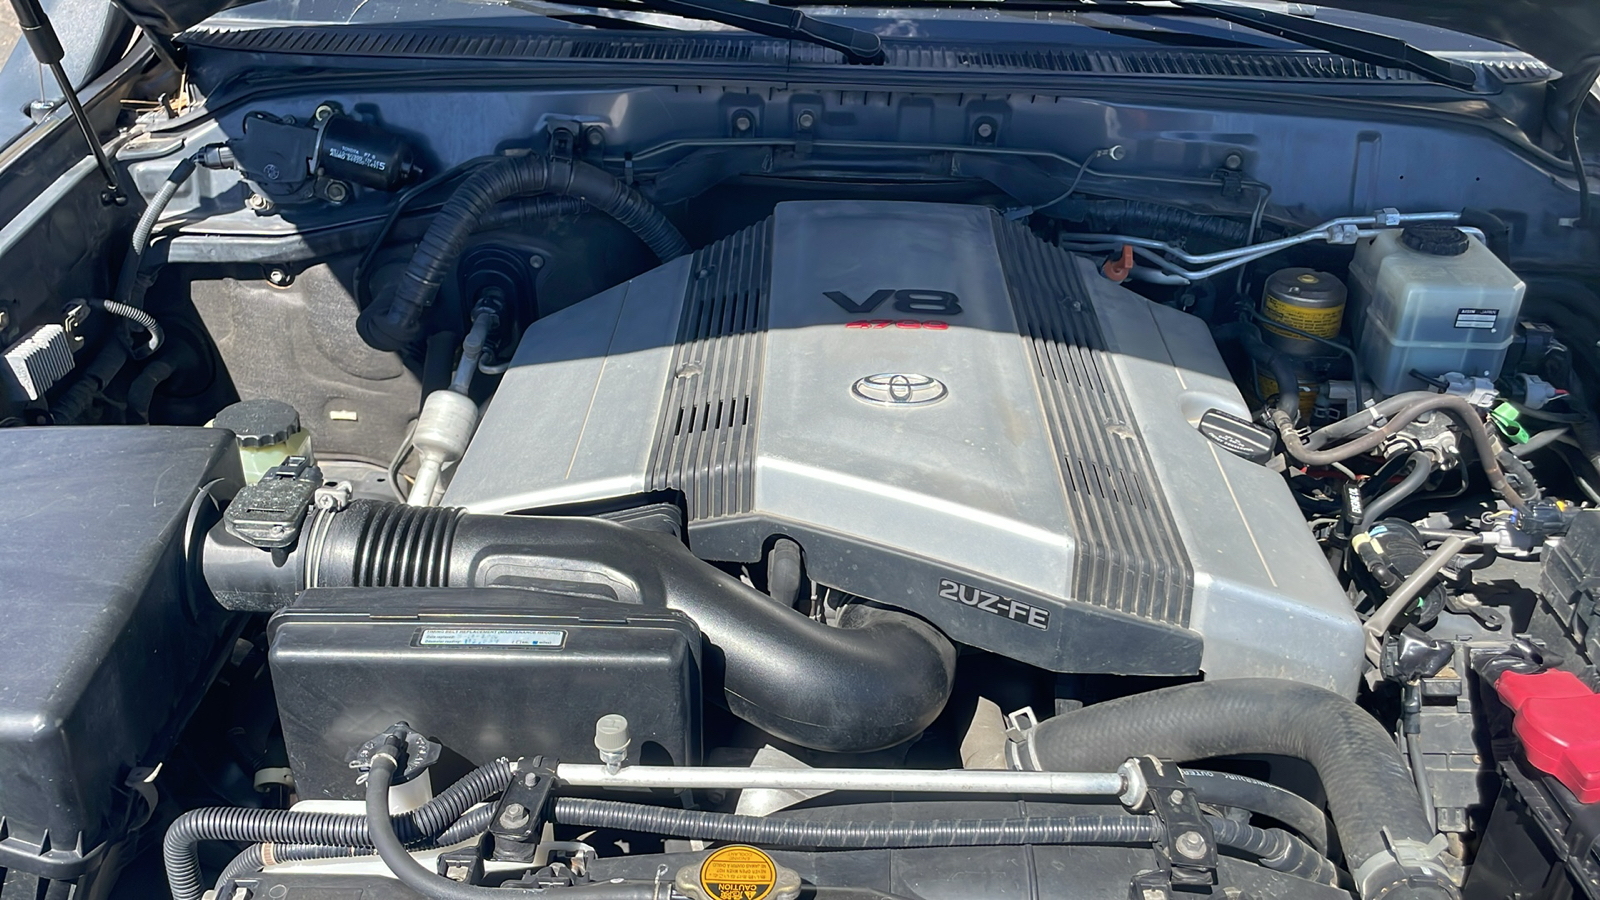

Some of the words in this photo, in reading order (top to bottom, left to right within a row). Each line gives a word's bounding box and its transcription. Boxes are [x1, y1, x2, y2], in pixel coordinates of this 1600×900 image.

[822, 289, 963, 316] V8
[845, 319, 950, 330] 4700
[1350, 494, 1363, 514] ENGINE
[939, 579, 1049, 630] 2UZ-FE
